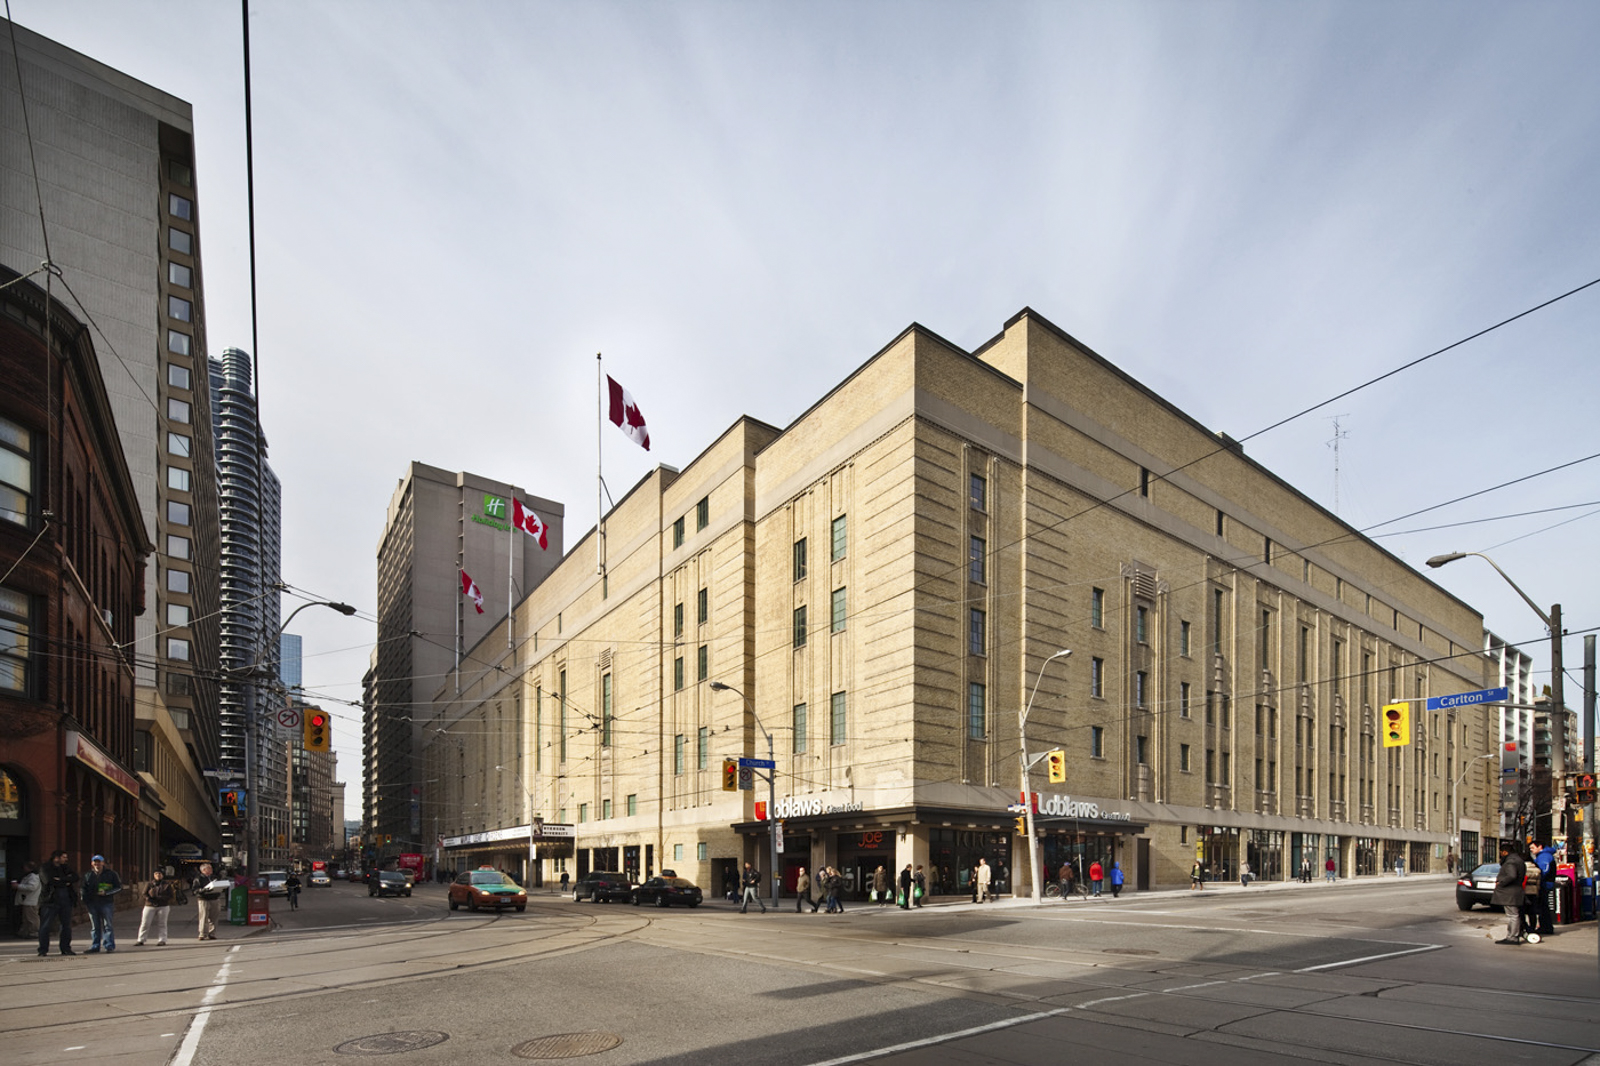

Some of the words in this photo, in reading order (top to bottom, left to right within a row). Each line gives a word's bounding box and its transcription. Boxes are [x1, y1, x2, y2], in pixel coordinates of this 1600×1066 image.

[471, 514, 503, 531] Holiday
[1440, 694, 1483, 706] Carlton
[745, 759, 766, 767] Church
[766, 797, 822, 819] Loblaws
[826, 804, 845, 814] Great
[844, 801, 863, 813] food
[1037, 792, 1099, 819] Loblaws
